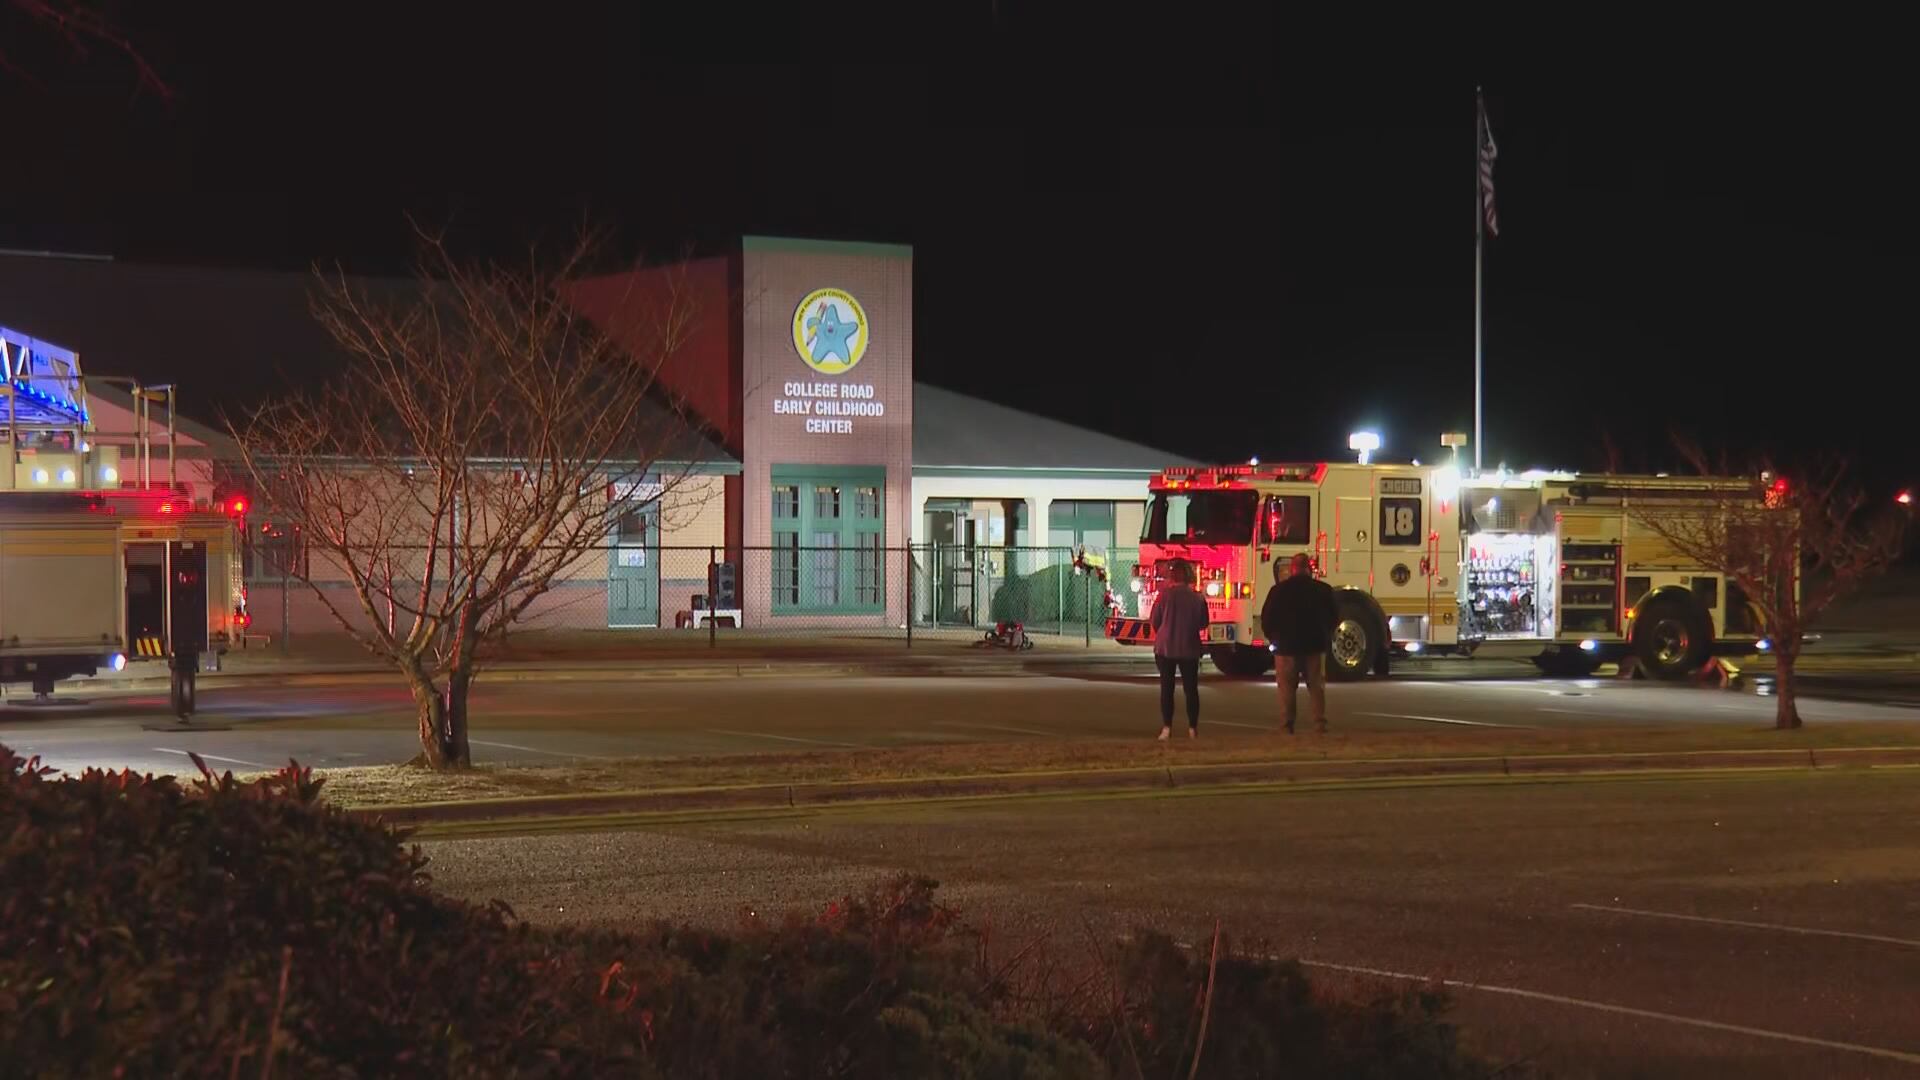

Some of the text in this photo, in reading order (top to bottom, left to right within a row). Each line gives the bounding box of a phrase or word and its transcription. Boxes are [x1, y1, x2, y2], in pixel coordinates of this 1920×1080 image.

[828, 290, 849, 303] COUNTY
[784, 382, 874, 399] COLLEGE ROAD
[774, 399, 884, 417] EARLY CHILDHOOD
[806, 419, 853, 434] CENTER
[1385, 506, 1414, 537] 18
